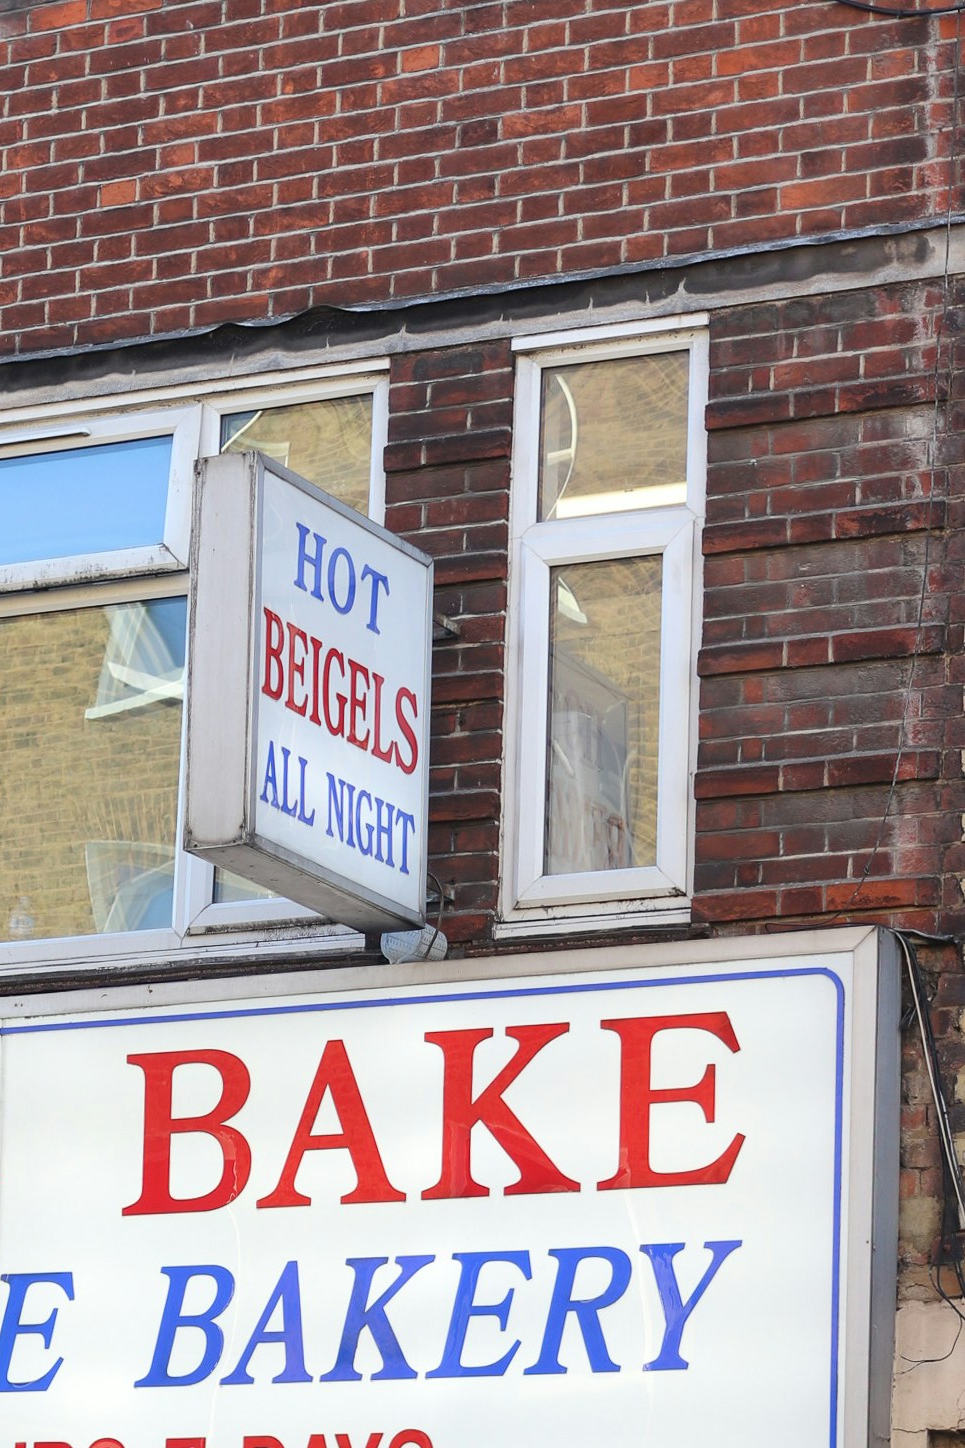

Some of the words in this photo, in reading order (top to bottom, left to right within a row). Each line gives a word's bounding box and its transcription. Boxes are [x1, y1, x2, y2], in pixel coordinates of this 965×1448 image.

[293, 521, 391, 636] HOT
[262, 606, 419, 774] BEIGELS
[260, 740, 316, 828] ALL
[325, 771, 416, 875] NIGHT
[122, 1011, 745, 1216] BAKE
[134, 1240, 744, 1388] BAKERY
